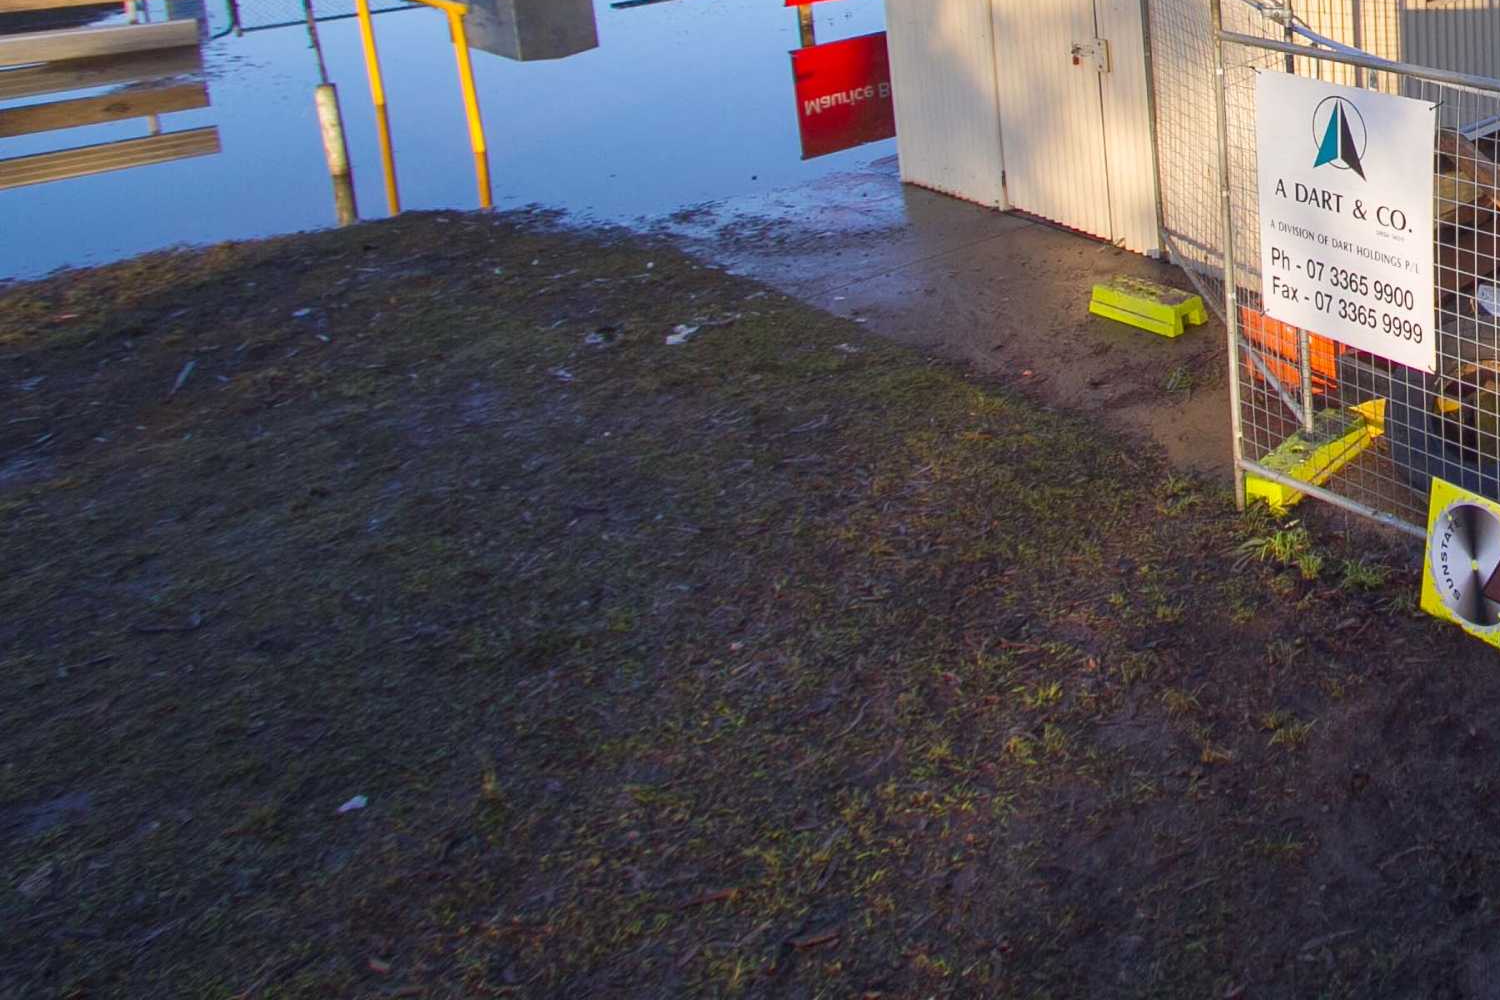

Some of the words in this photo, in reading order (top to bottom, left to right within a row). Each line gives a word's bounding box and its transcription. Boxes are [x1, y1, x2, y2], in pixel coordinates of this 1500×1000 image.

[1275, 178, 1287, 198] A
[1294, 183, 1344, 213] DART
[1353, 199, 1368, 221] &
[1376, 206, 1412, 233] CO.
[1270, 219, 1276, 229] A
[1278, 221, 1315, 241] DIVISION
[1317, 234, 1329, 246] OF
[1332, 238, 1353, 253] DART
[1356, 246, 1401, 268] HOLDINGS
[1271, 246, 1290, 271] Ph
[1306, 259, 1325, 281] 07
[1329, 266, 1368, 296] 3365
[1373, 280, 1414, 310] 9900
[1272, 276, 1299, 303] Fax
[1315, 290, 1333, 313] 07
[1338, 298, 1377, 329] 3365
[1382, 313, 1423, 344] 9999
